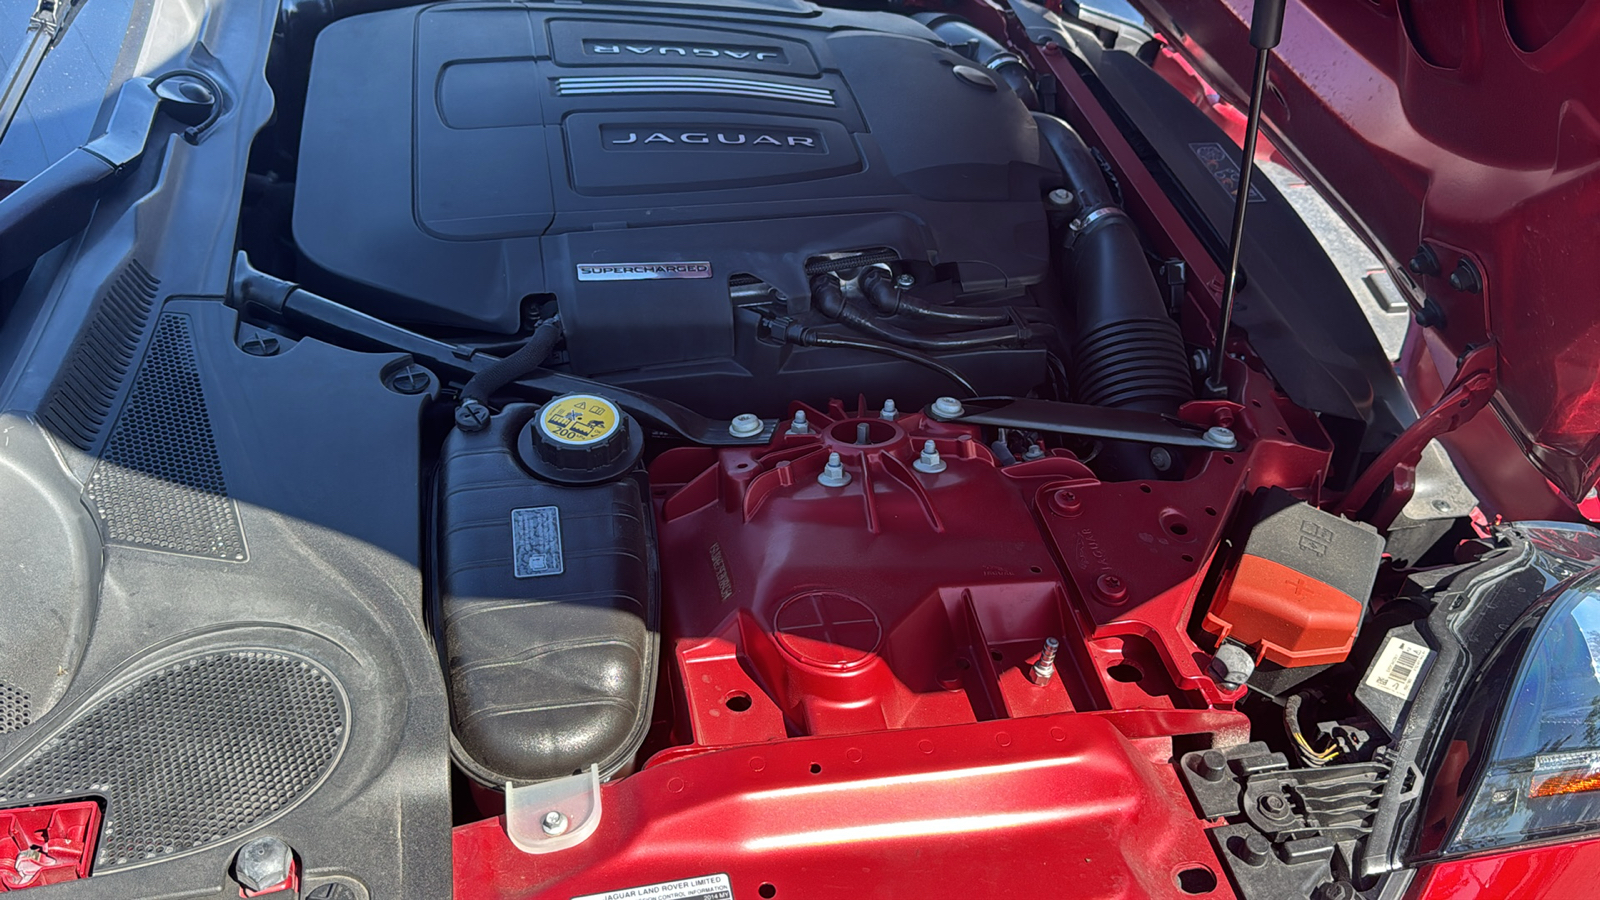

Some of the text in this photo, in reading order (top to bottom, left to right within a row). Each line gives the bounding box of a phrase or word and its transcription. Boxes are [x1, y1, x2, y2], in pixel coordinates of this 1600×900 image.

[594, 45, 777, 60] JAGUAR
[612, 132, 815, 147] JAGUAR
[581, 265, 708, 274] SUPERCHARGED
[553, 426, 576, 440] 200
[603, 876, 721, 900] JAGUAR LAND ROVER LIMITED
[658, 891, 686, 900] CONTROL
[688, 885, 728, 896] INFORMATION
